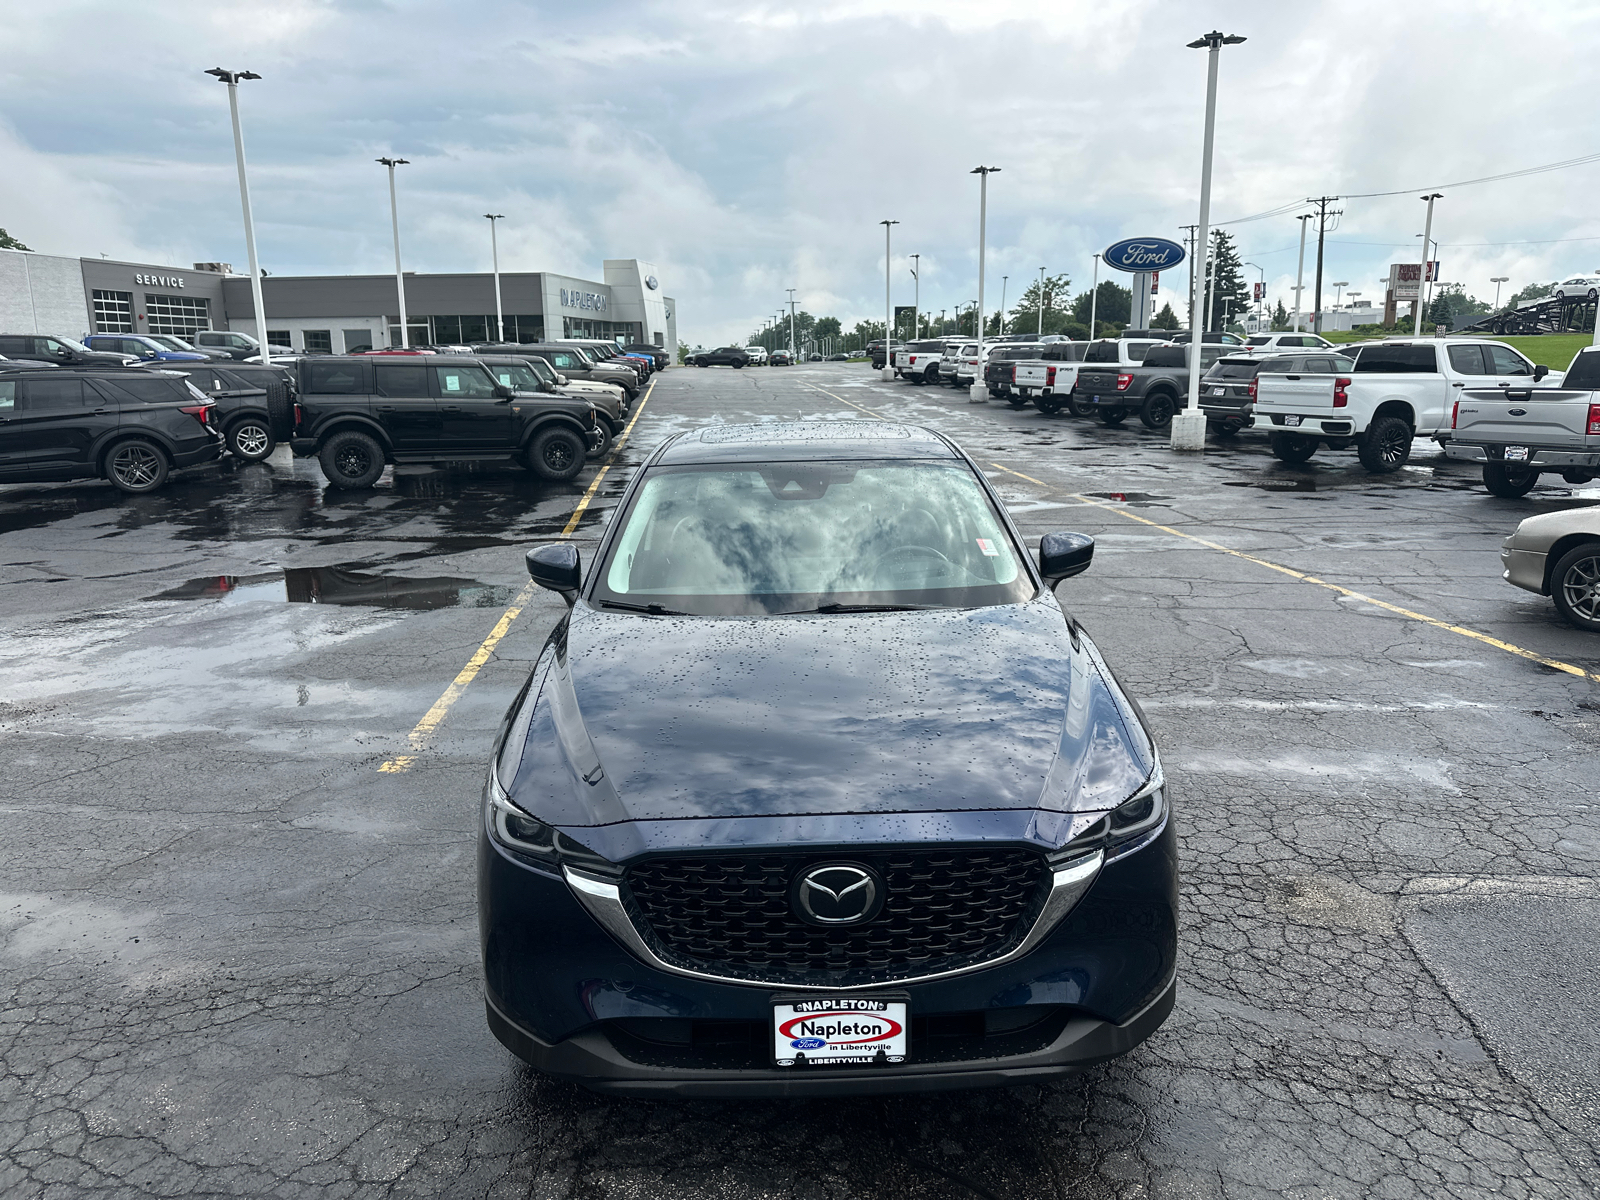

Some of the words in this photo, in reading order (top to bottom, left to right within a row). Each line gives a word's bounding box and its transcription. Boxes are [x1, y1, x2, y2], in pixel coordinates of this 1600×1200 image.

[1122, 243, 1170, 264] Ford
[136, 273, 185, 288] SERVICE
[560, 288, 607, 311] NAPLETON
[801, 999, 878, 1011] NAPLETON
[800, 1020, 882, 1039] Napleton
[798, 1039, 820, 1048] Ford
[809, 1056, 874, 1065] LIBERTYVILLE
